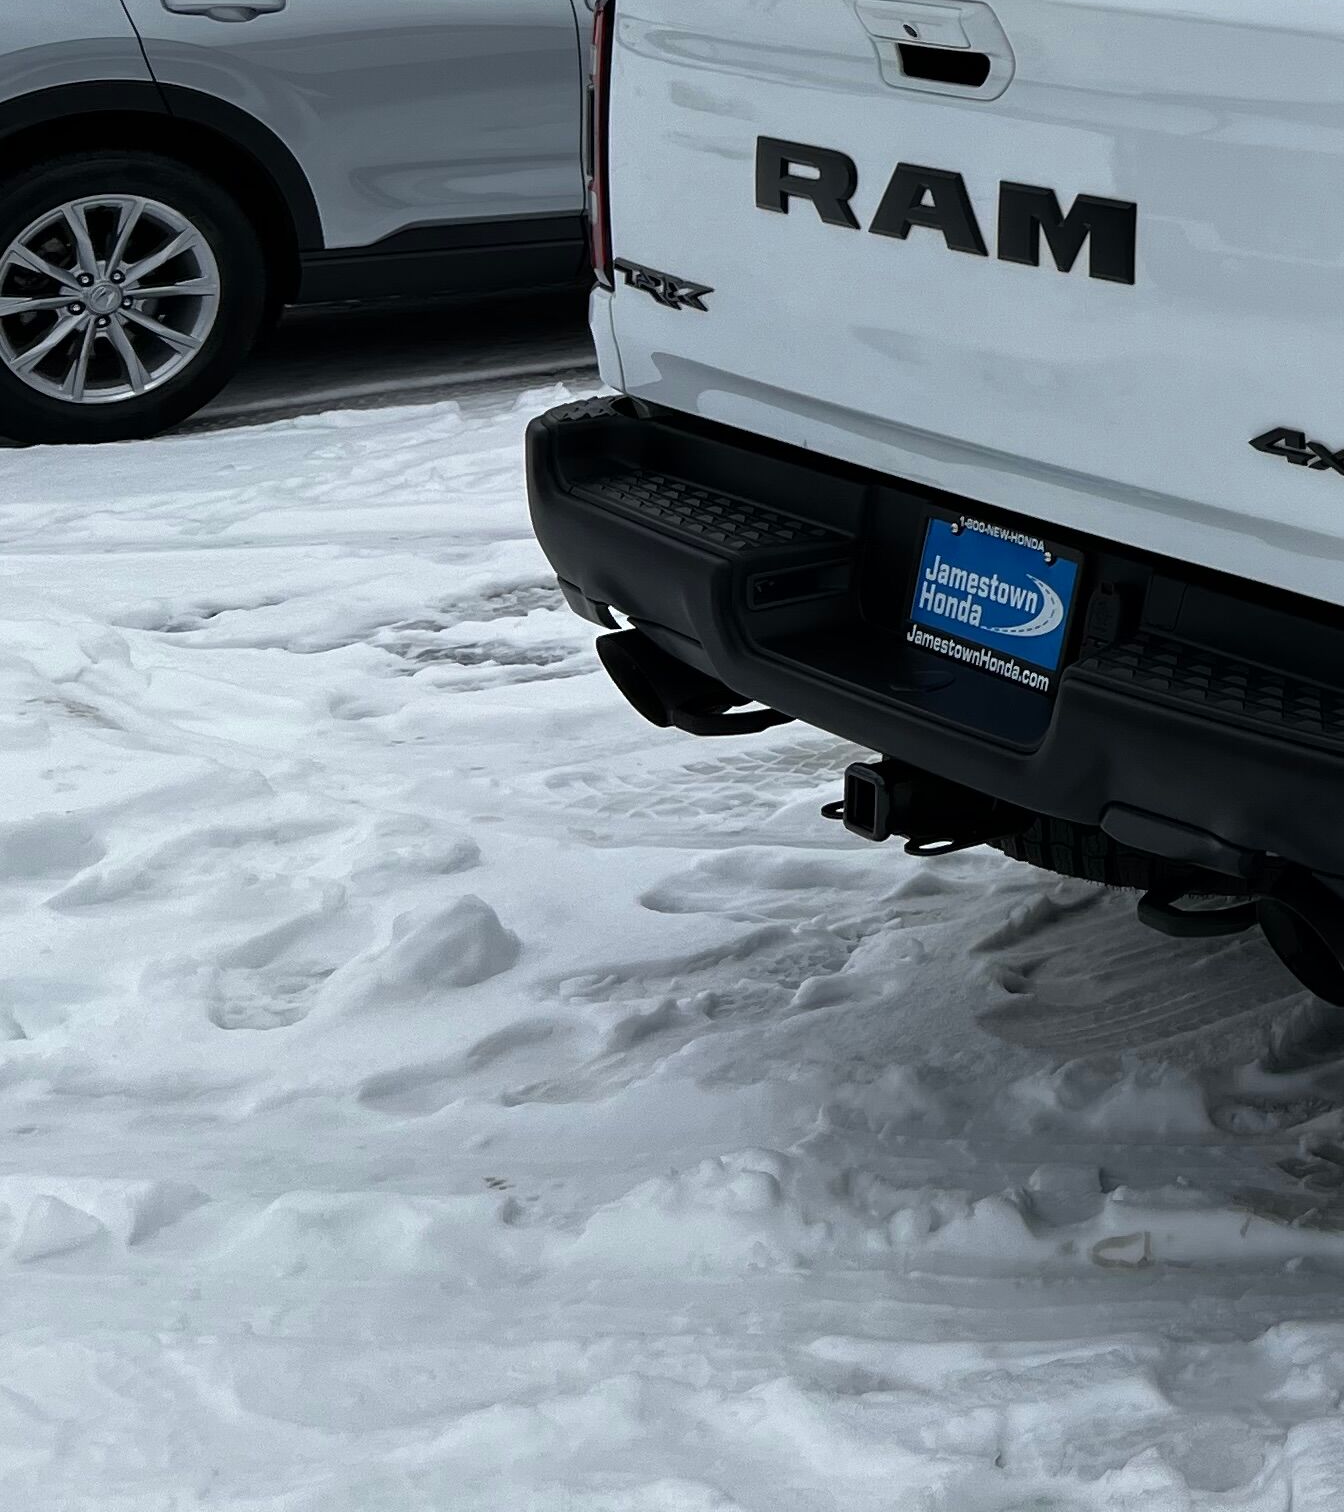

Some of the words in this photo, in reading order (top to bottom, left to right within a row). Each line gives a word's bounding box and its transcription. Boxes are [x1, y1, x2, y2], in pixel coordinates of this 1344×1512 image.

[756, 135, 1137, 286] RAM
[614, 257, 715, 313] TRX
[959, 515, 1045, 552] 1-800-NEW-HONDA
[918, 581, 983, 627] Honda
[925, 555, 1038, 614] Jamestown
[906, 624, 1049, 691] JamestownHonda.com
